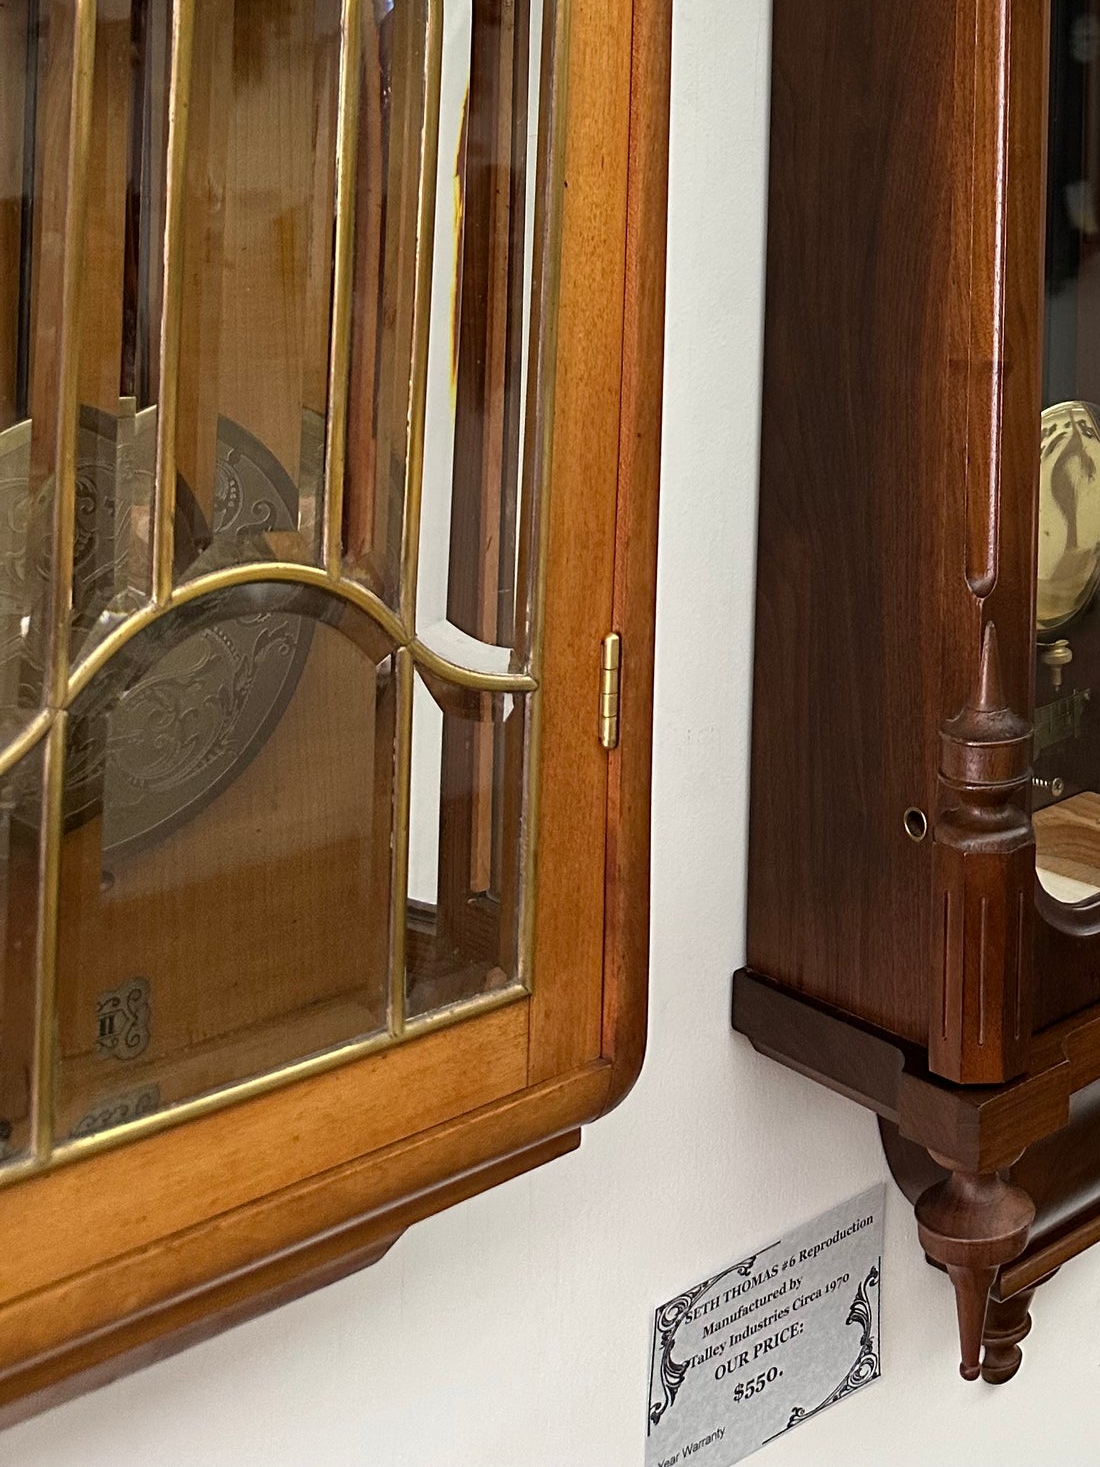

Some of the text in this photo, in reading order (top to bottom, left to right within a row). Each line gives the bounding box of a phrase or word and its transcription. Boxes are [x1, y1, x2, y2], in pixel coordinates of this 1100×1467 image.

[685, 1295, 721, 1324] SETH
[722, 1264, 779, 1304] THOMAS
[798, 1215, 874, 1264] Reproduction
[688, 1273, 850, 1369] Talley Industries Circa 1970
[701, 1276, 803, 1339] Manufactured by
[714, 1322, 804, 1380] OUR PRICE:
[733, 1366, 784, 1403] $550.
[681, 1426, 726, 1458] Warranty
